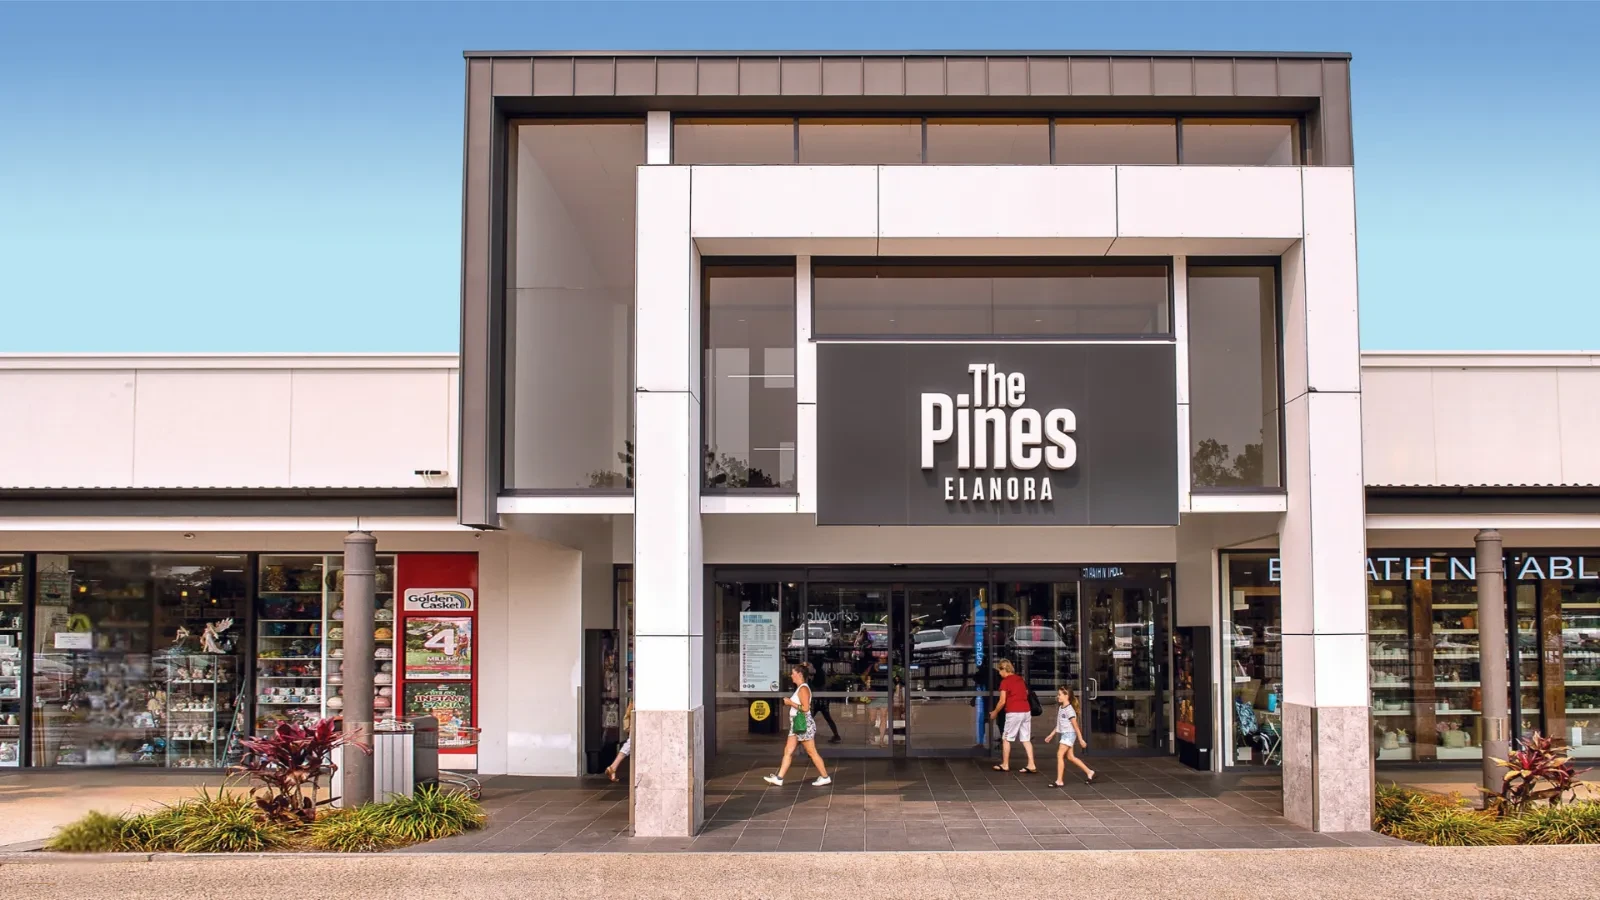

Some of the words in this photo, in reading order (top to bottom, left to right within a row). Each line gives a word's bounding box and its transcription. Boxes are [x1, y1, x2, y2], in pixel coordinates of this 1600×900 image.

[968, 363, 1026, 408] The
[921, 392, 1077, 471] Pines
[944, 477, 1053, 501] ELANORA
[1366, 557, 1431, 580] ATH
[408, 594, 454, 603] Golden
[420, 601, 459, 610] Casket
[791, 608, 860, 621] olworths
[414, 694, 465, 702] INSTANT
[422, 701, 462, 709] SANTA
